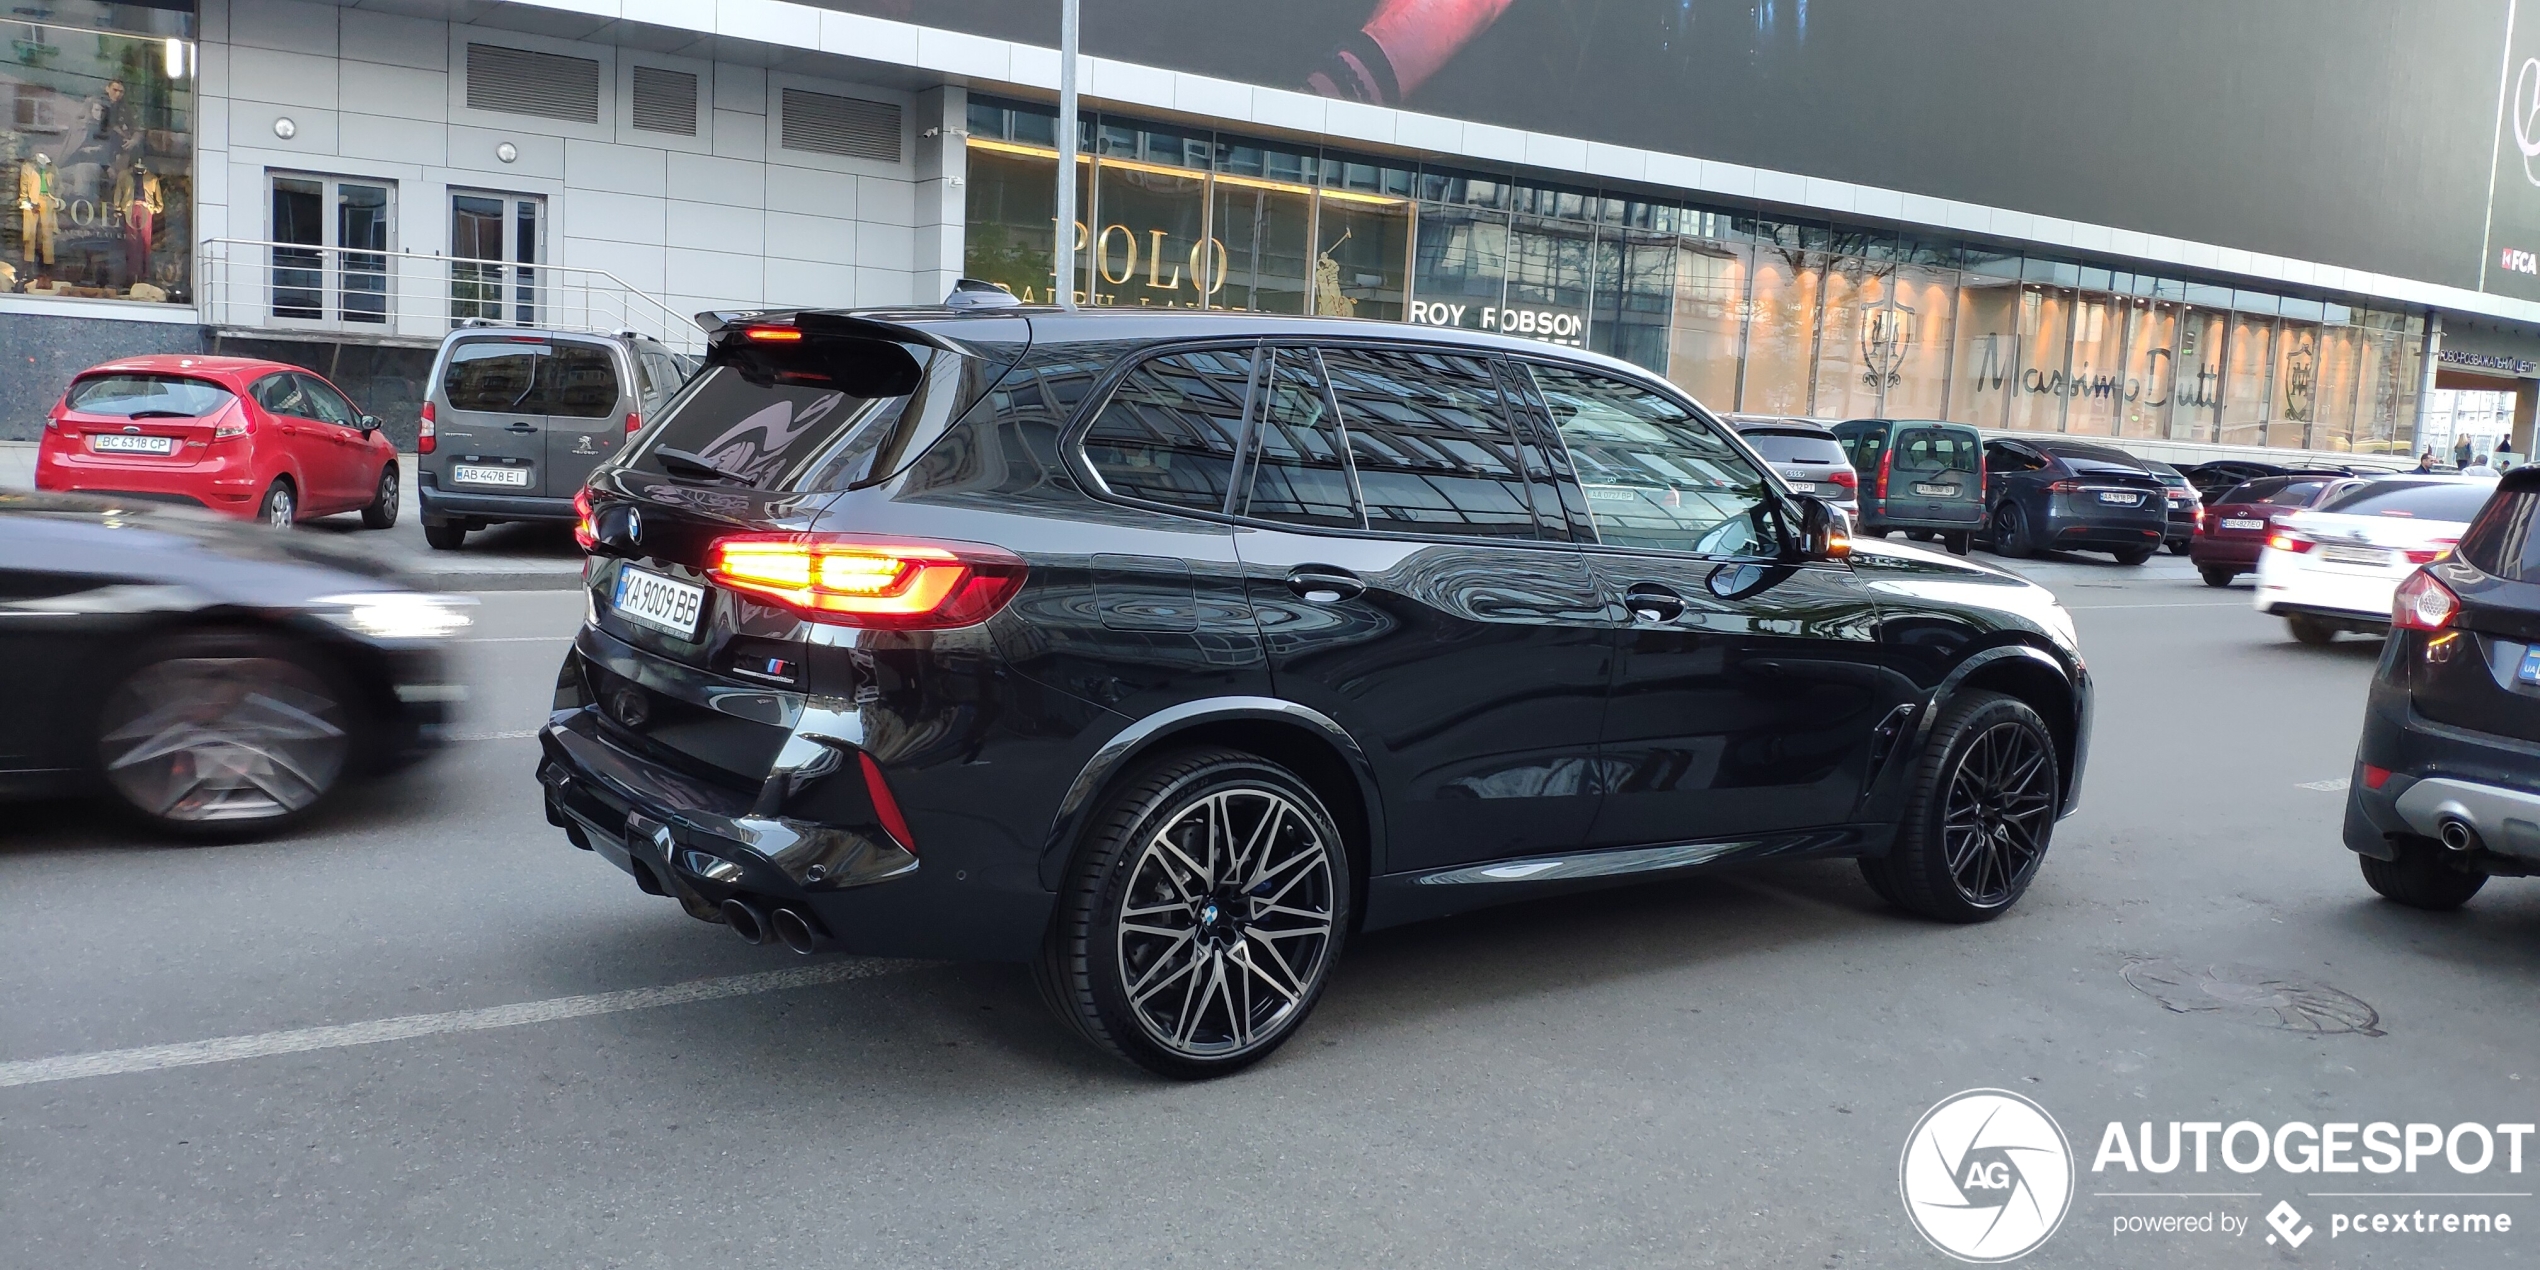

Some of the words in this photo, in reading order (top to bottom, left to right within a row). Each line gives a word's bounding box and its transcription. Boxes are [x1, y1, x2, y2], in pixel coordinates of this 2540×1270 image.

[48, 198, 148, 230] POLO
[1050, 217, 1227, 294] POLO
[1410, 301, 1466, 326] ROY
[1483, 307, 1582, 336] ROBSON
[102, 436, 119, 447] BC
[121, 437, 147, 449] 6318
[150, 439, 167, 450] CP
[462, 469, 478, 480] AB
[480, 470, 504, 481] 4478
[507, 472, 520, 482] EI
[622, 573, 642, 609] KA
[640, 580, 675, 618] 9009
[673, 589, 699, 626] BB
[2524, 664, 2536, 674] UA
